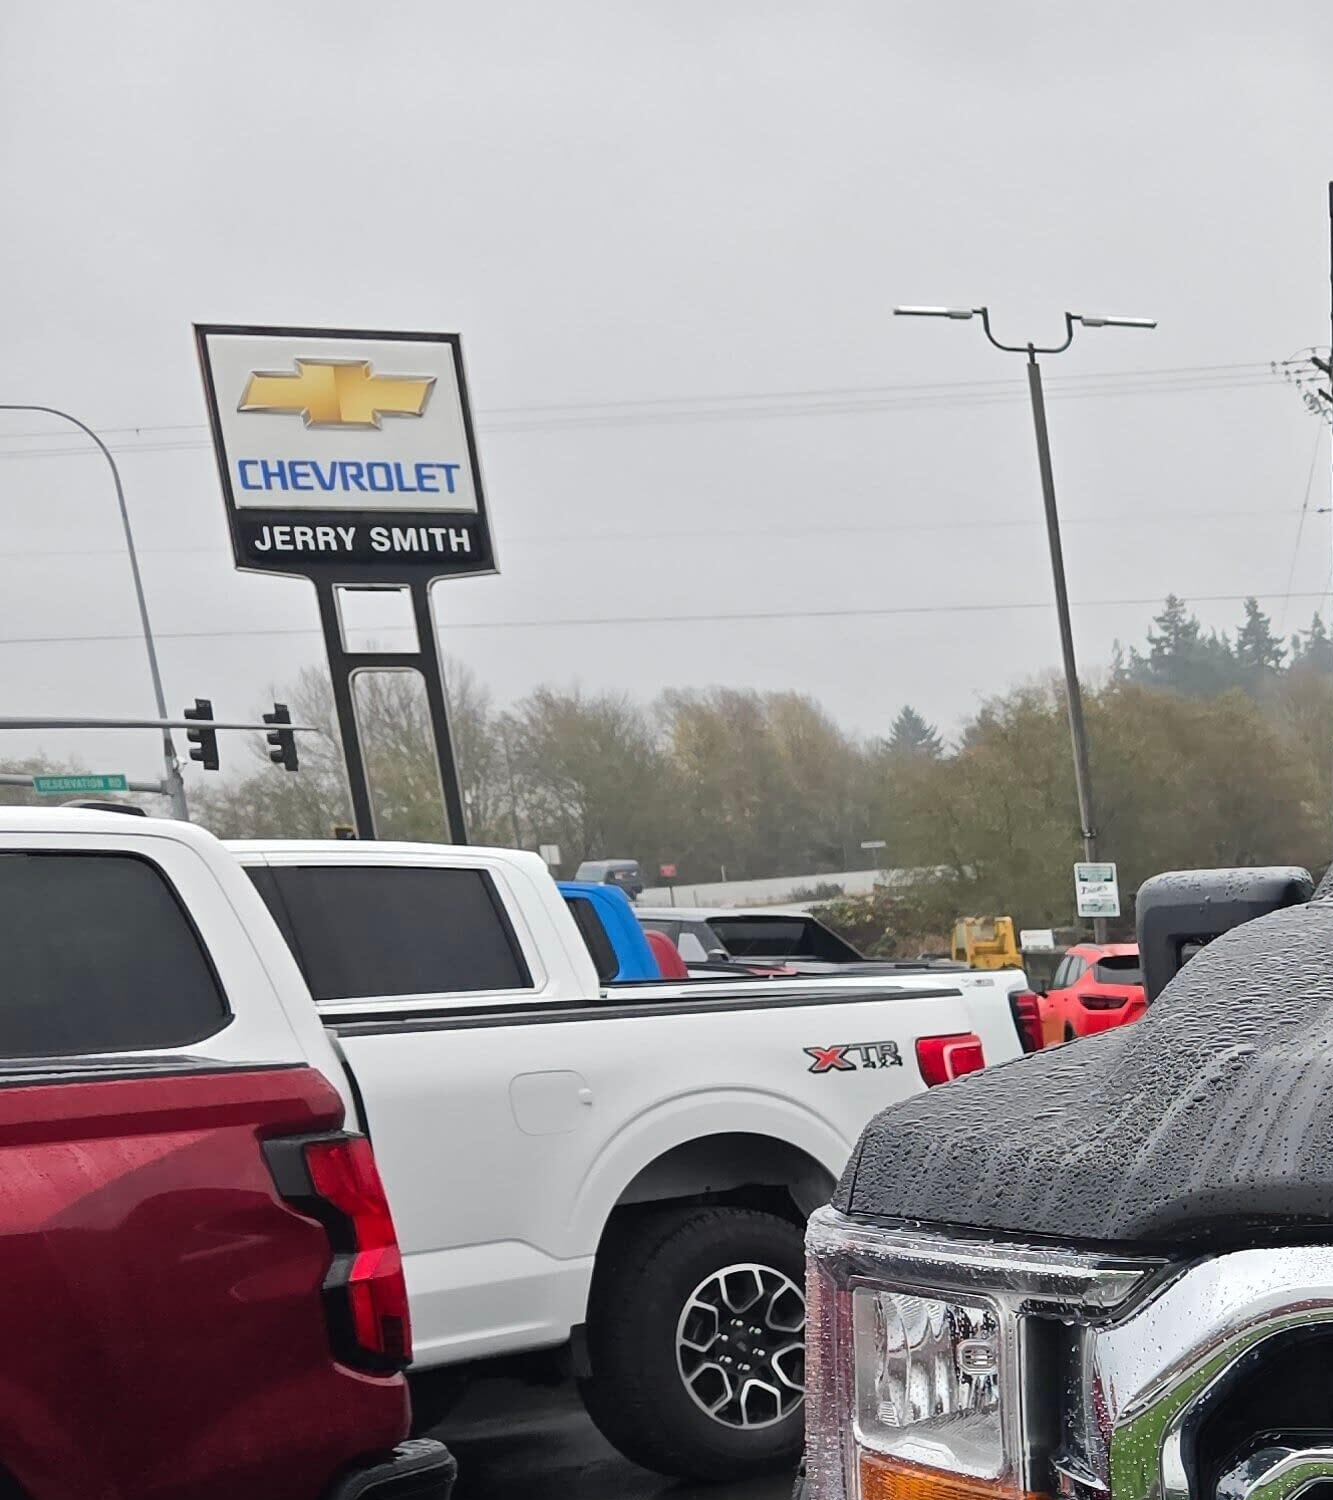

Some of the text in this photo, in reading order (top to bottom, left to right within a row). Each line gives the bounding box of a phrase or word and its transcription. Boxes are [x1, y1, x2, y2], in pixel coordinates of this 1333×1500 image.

[238, 459, 461, 493] CHEVROLET
[254, 526, 472, 553] JERRY SMITH
[803, 1040, 899, 1074] XTR
